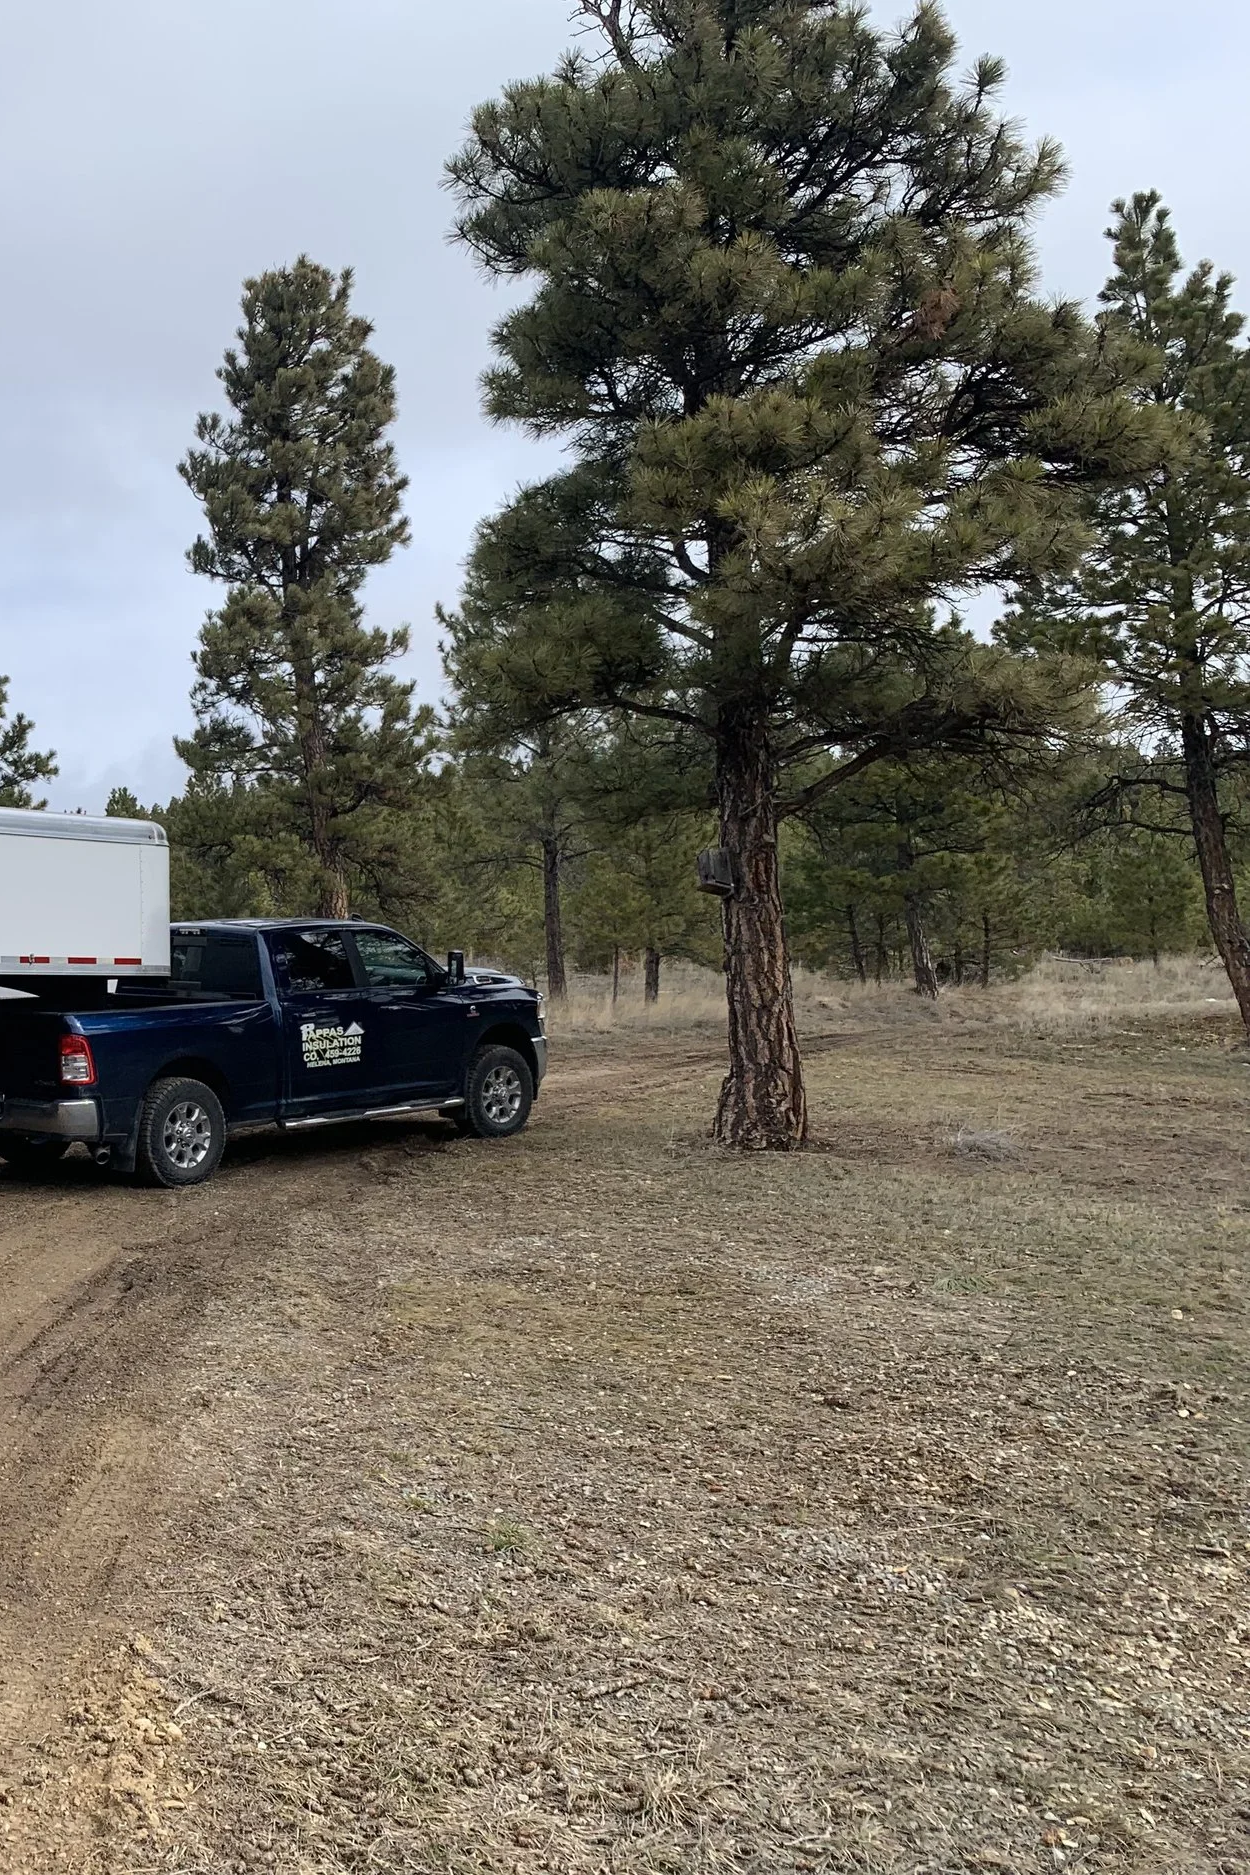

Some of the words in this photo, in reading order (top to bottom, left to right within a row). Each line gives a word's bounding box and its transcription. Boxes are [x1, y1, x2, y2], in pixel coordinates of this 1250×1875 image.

[300, 1023, 344, 1041] PAPPAS
[302, 1036, 361, 1052] INSULATION
[325, 1046, 361, 1059] 459-4226
[332, 1056, 360, 1064] MONTANA
